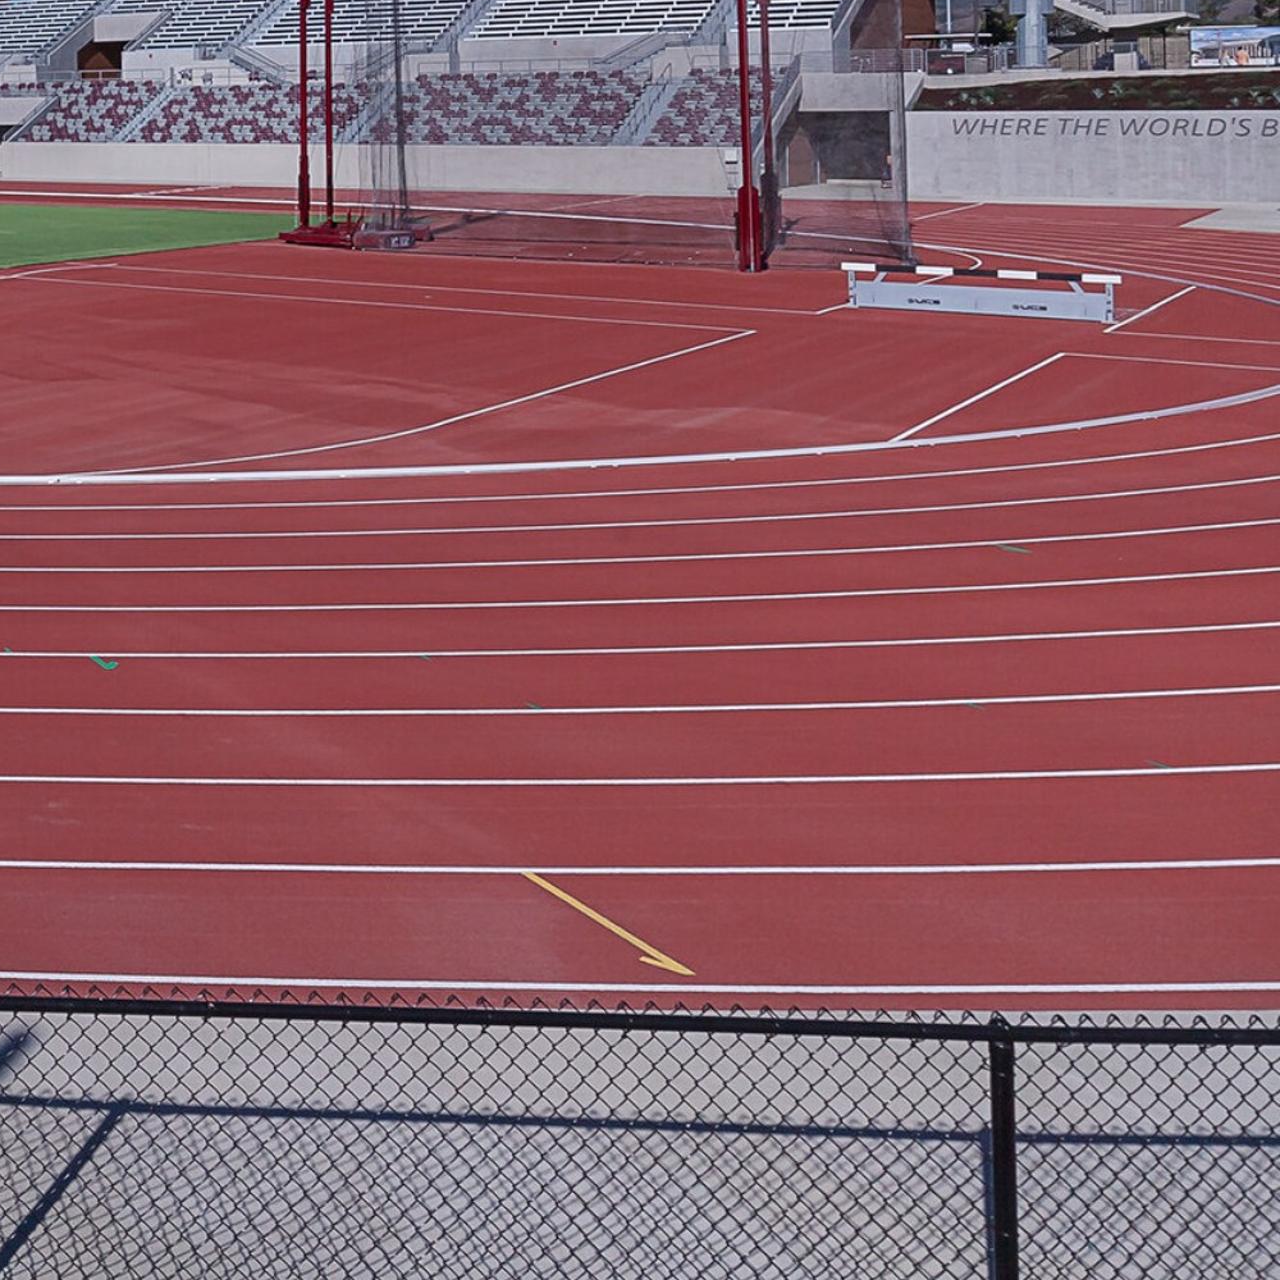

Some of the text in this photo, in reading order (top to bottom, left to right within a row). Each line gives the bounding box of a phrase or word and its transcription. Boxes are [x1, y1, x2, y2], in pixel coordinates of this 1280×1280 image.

[952, 118, 1049, 136] WHERE
[1057, 118, 1111, 136] THE
[1120, 117, 1252, 137] WORLD'S
